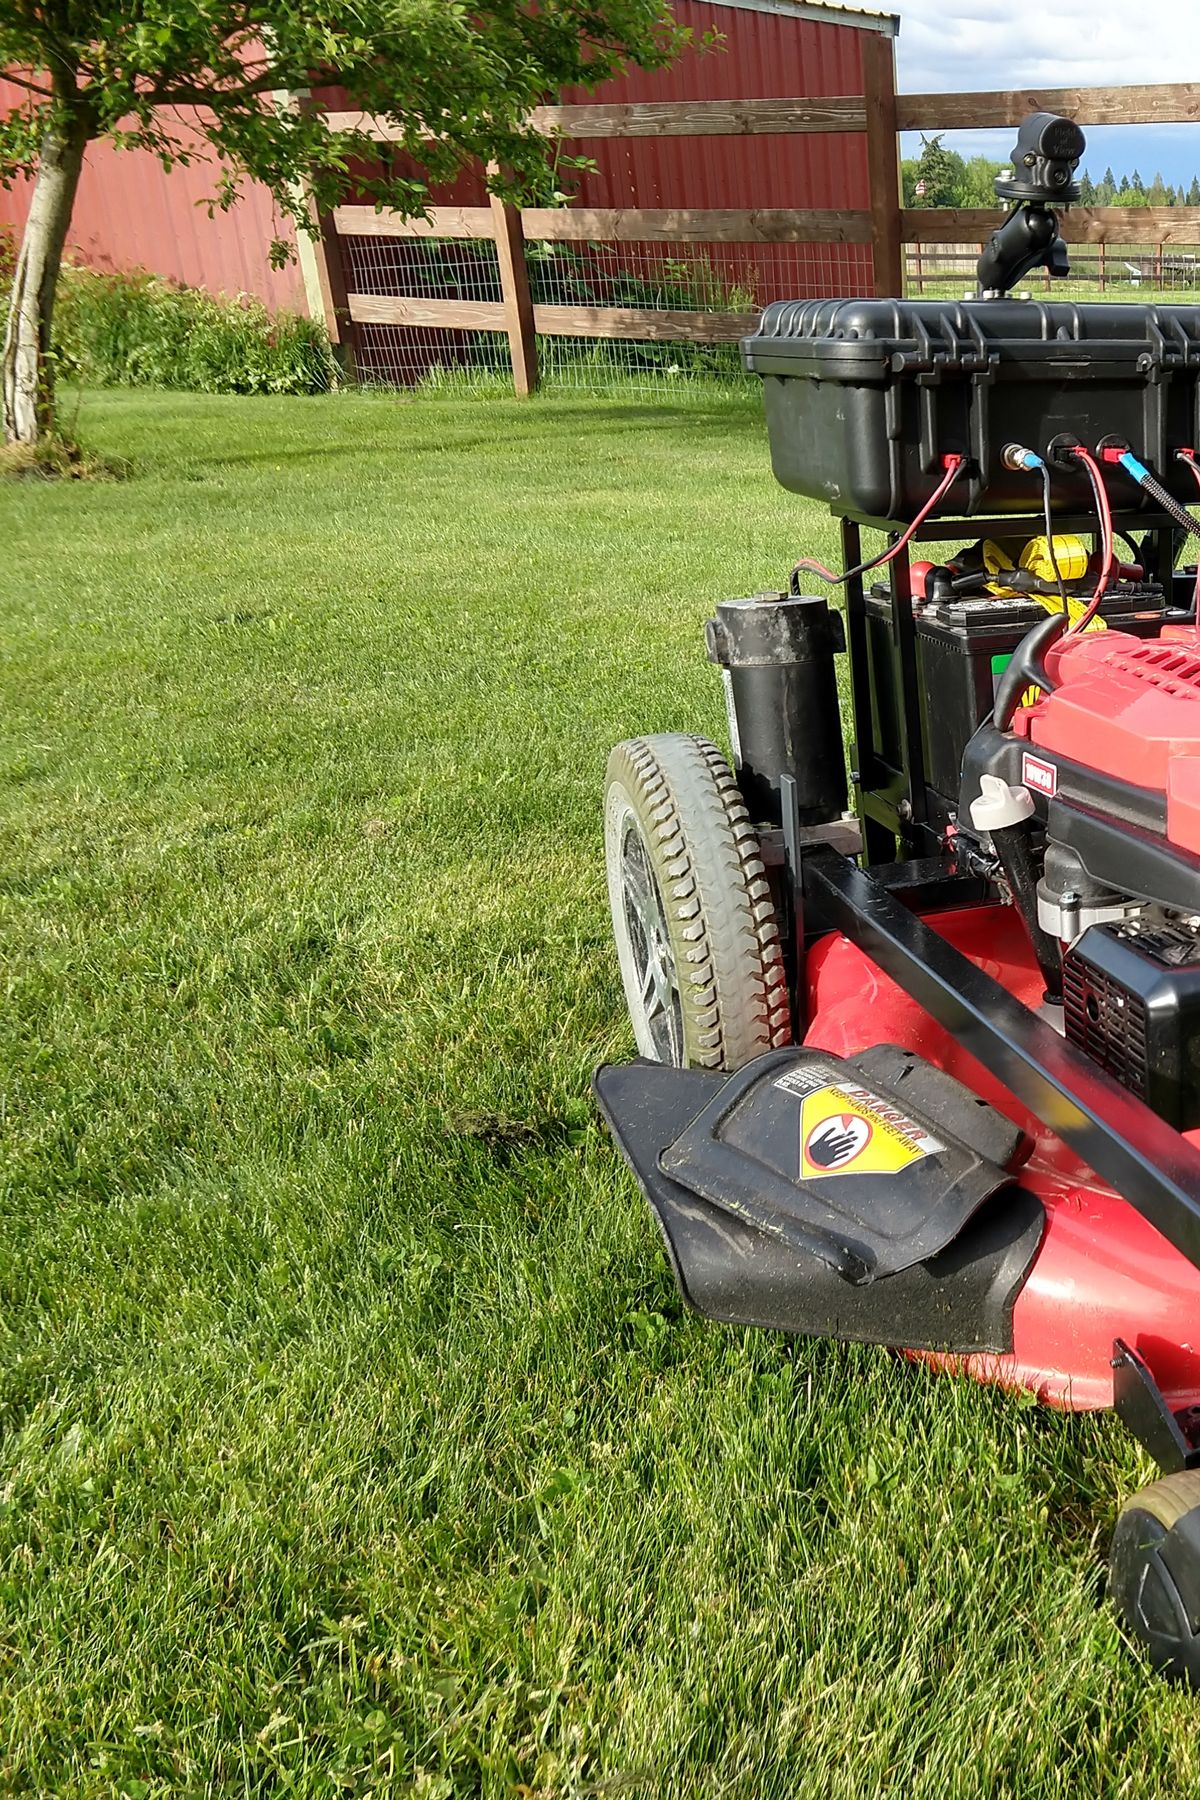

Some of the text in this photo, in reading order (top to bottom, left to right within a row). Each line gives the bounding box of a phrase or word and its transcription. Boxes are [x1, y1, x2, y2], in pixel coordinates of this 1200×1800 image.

[828, 1087, 847, 1100] KEEP
[881, 1121, 900, 1137] FEET
[897, 1136, 922, 1154] AWAY
[848, 1090, 928, 1141] DANGER
